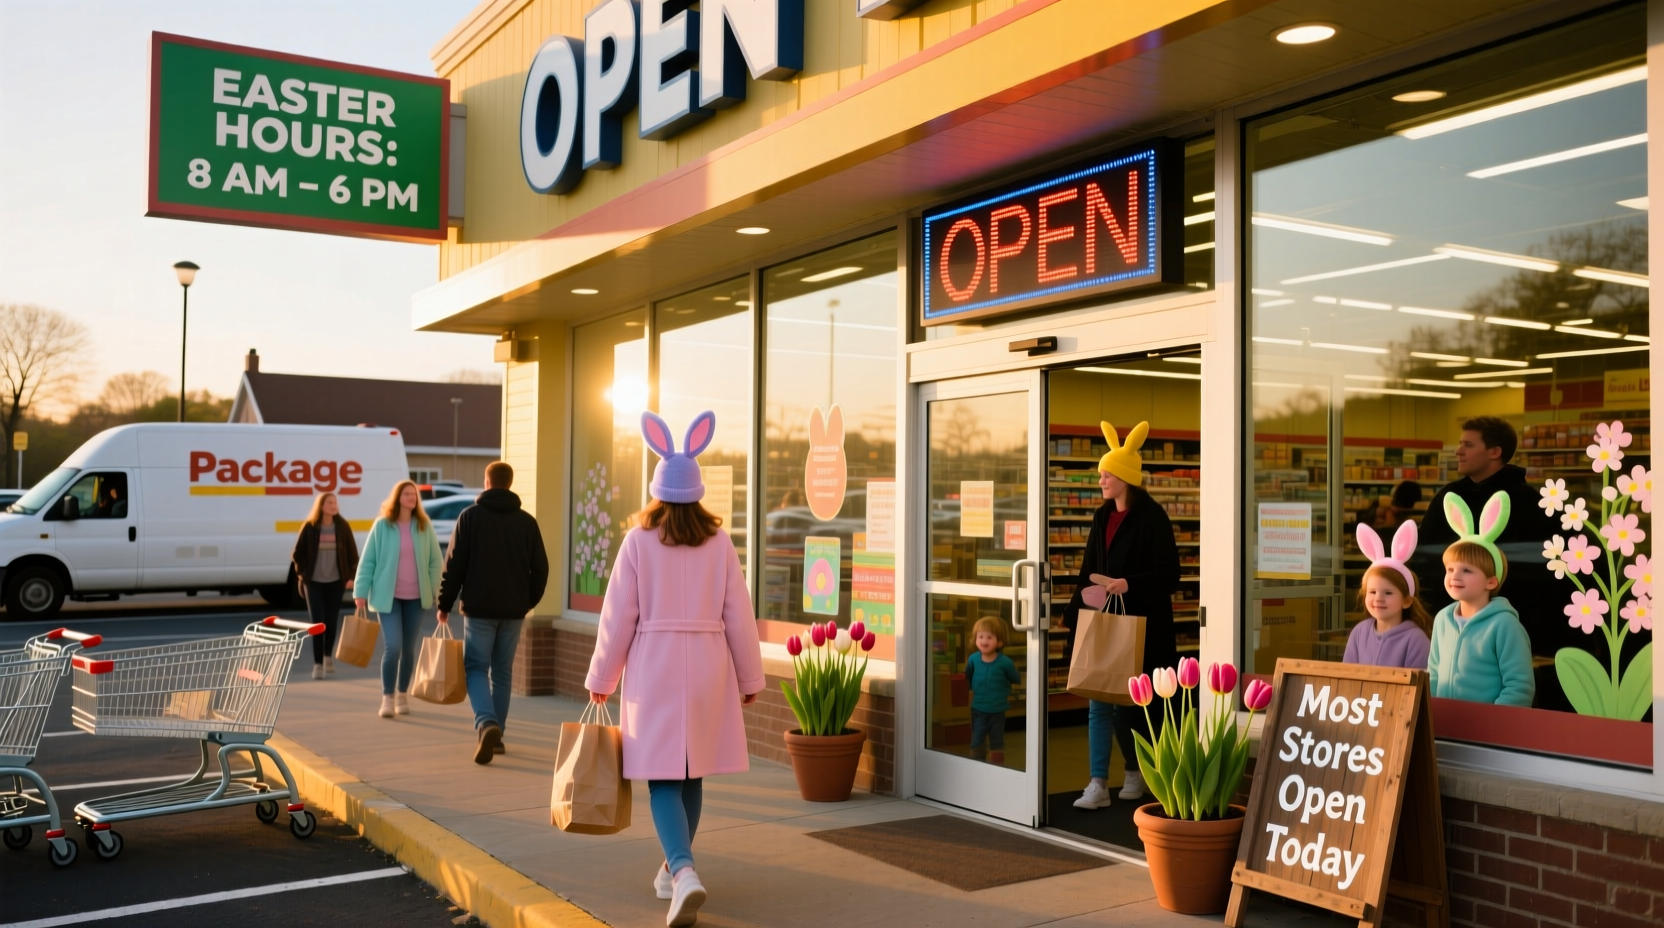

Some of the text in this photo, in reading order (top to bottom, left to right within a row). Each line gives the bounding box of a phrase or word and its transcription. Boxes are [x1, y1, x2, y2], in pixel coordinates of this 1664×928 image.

[213, 68, 396, 127] EASTER
[215, 111, 398, 167] HOURS:
[187, 158, 212, 189] 8
[221, 162, 288, 198] AM
[328, 174, 351, 205] 6
[362, 177, 419, 212] PM
[940, 171, 1138, 301] OPEN
[189, 451, 363, 492] Package
[1296, 683, 1383, 727] Most
[1279, 726, 1385, 776] Stores
[1278, 774, 1366, 825] Open
[1265, 822, 1366, 890] Today
